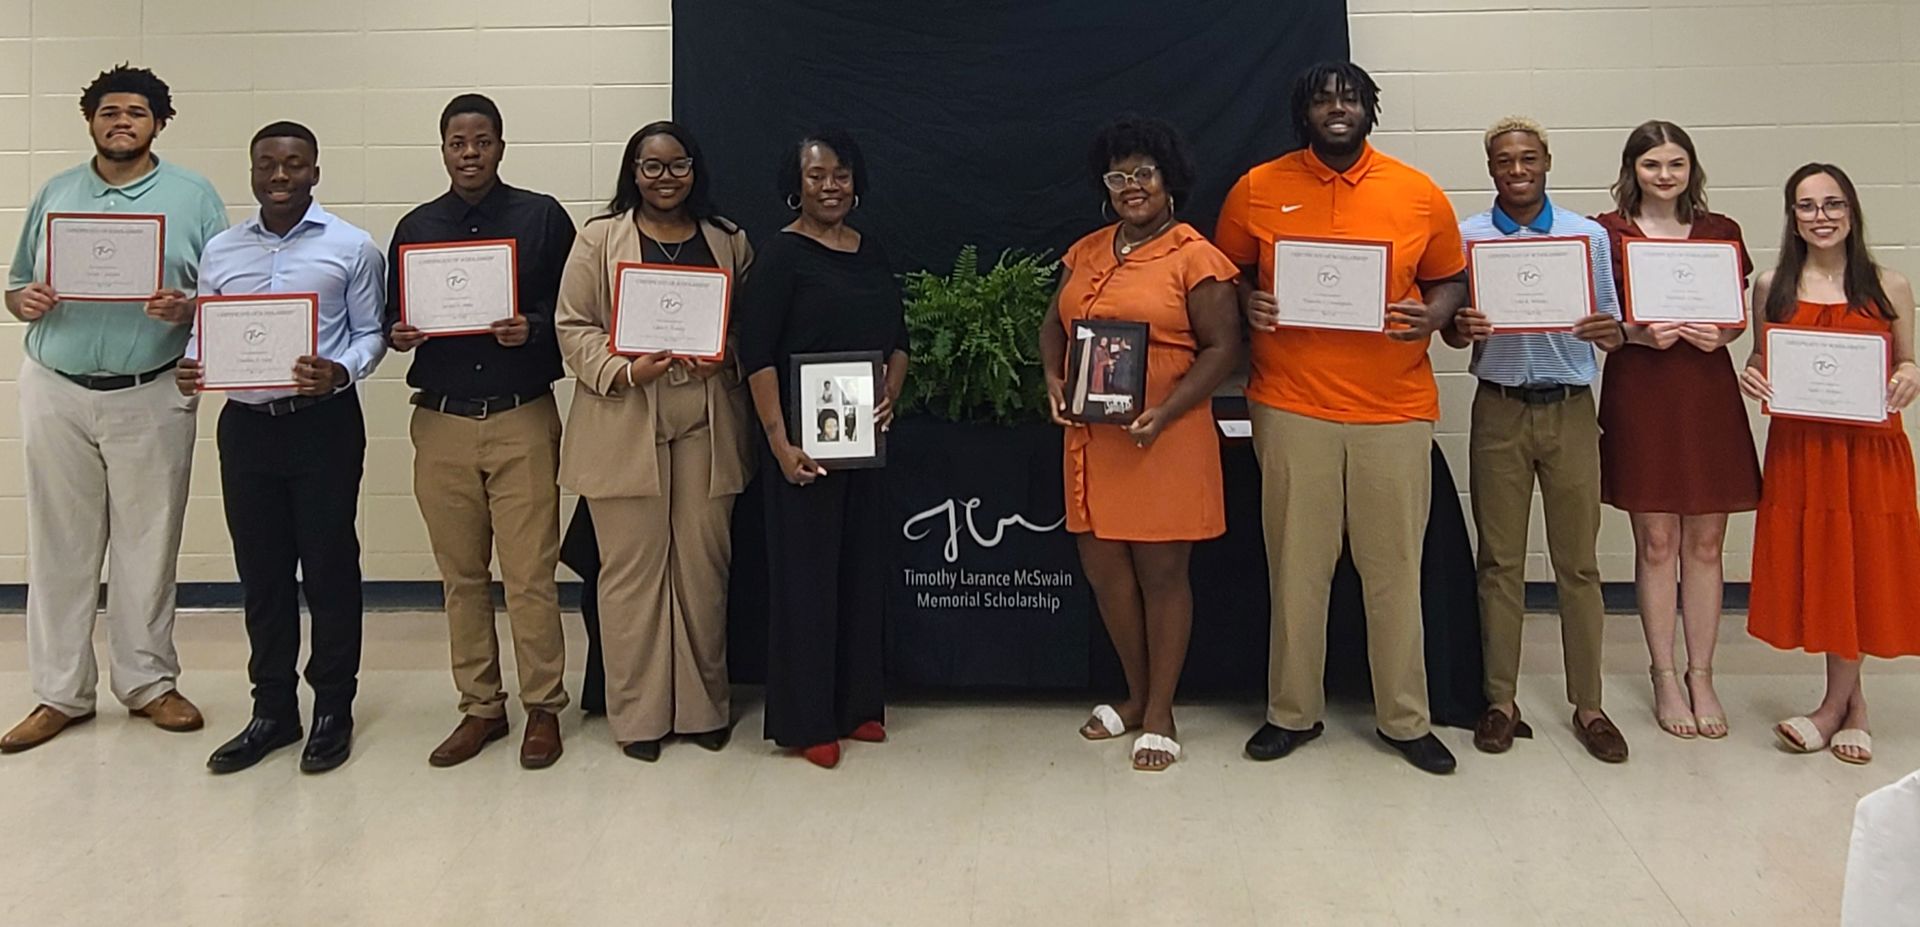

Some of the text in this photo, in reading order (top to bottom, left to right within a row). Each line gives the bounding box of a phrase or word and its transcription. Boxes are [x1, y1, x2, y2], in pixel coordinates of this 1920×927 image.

[904, 568, 1072, 589] Timothy Larance McSwain
[917, 591, 1060, 614] Memorial Scholarship
